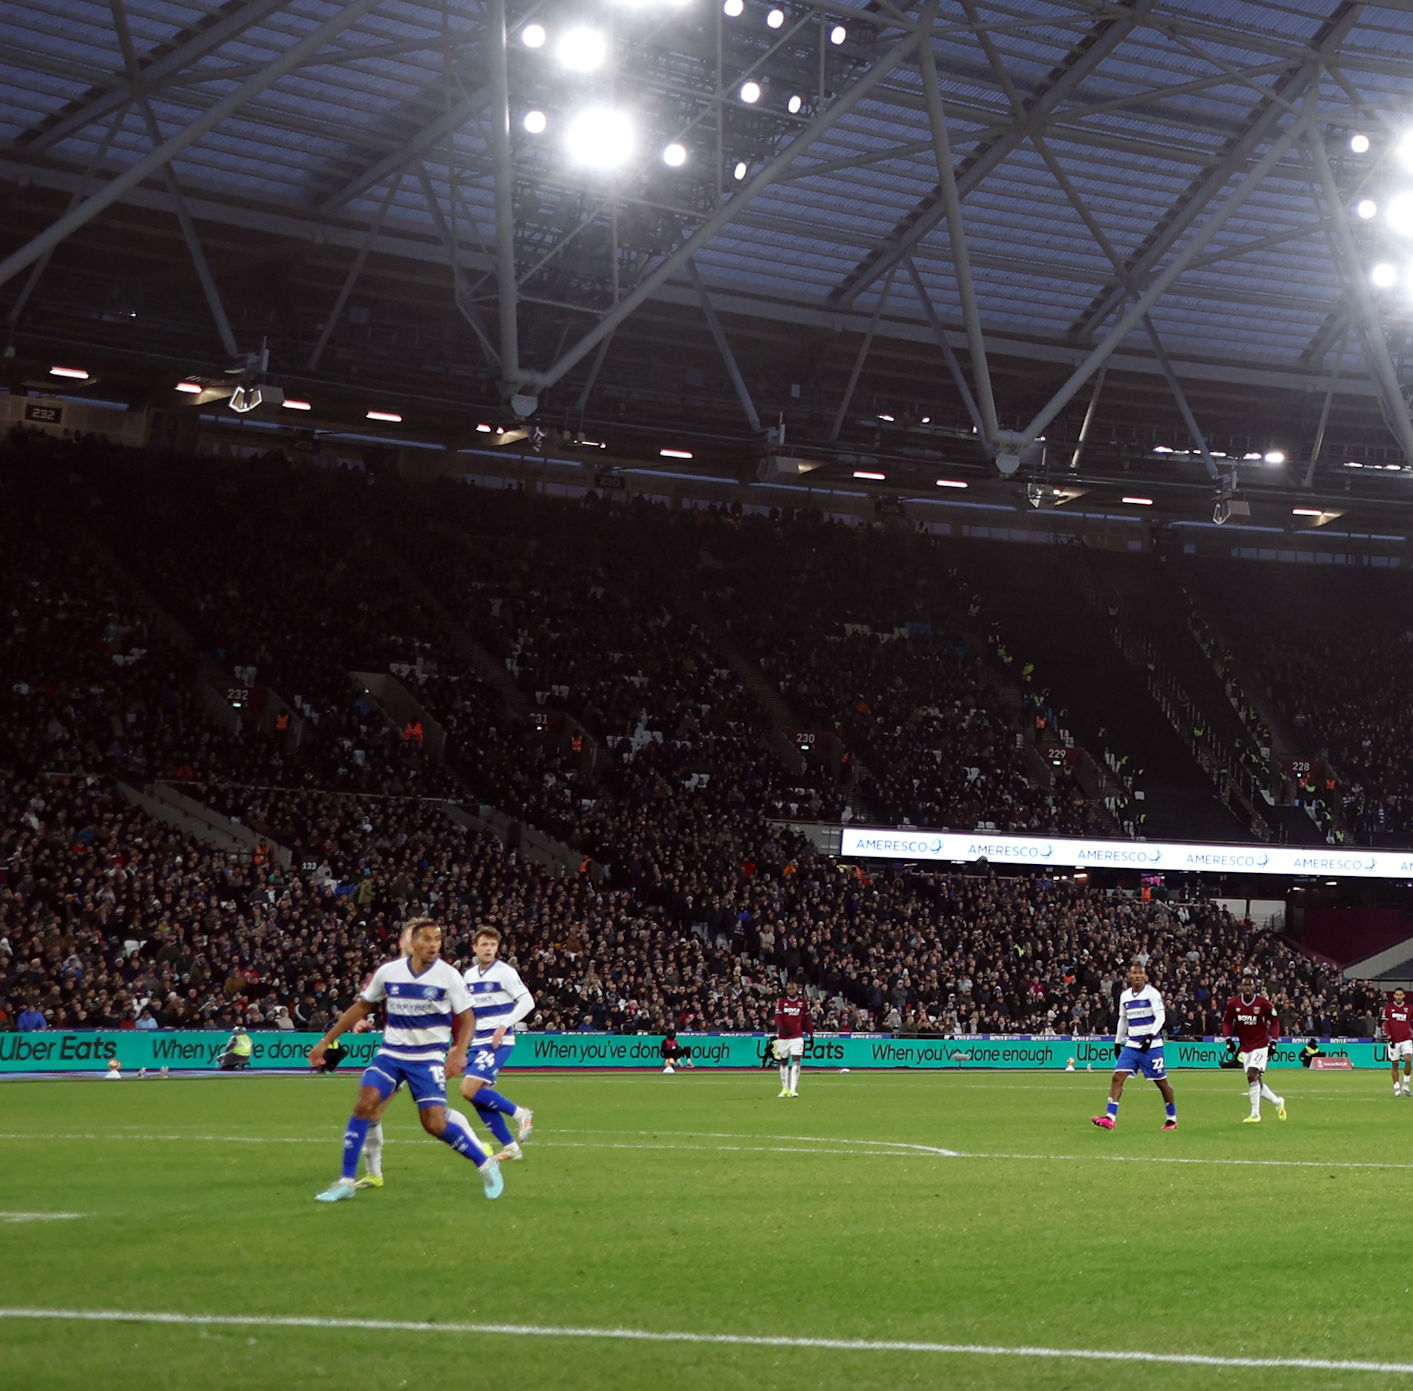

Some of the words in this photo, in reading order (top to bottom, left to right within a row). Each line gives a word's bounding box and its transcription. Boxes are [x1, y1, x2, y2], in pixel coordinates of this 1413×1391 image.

[227, 688, 249, 701] 232
[796, 733, 815, 744] 230
[1048, 748, 1067, 760] 229
[1292, 761, 1310, 772] 228
[857, 839, 928, 852] AMERESCO
[968, 844, 1038, 858] AMERESCO
[1078, 849, 1147, 863] AMERESCO
[1186, 854, 1255, 866] AMERESCO
[1294, 858, 1363, 870] AMERESCO
[0, 1037, 56, 1060] Uber
[61, 1036, 117, 1060] Eats
[153, 1038, 213, 1059] When
[268, 1039, 310, 1059] done
[533, 1039, 577, 1059] When
[580, 1039, 627, 1063] you've
[629, 1039, 662, 1059] don
[678, 1039, 730, 1064] nough
[872, 1043, 915, 1060] When
[969, 1044, 999, 1061] done
[1002, 1045, 1054, 1065] enough
[1076, 1041, 1114, 1061] Uber
[1179, 1047, 1217, 1063] When
[475, 1050, 496, 1069] 24
[1152, 1057, 1164, 1070] 22
